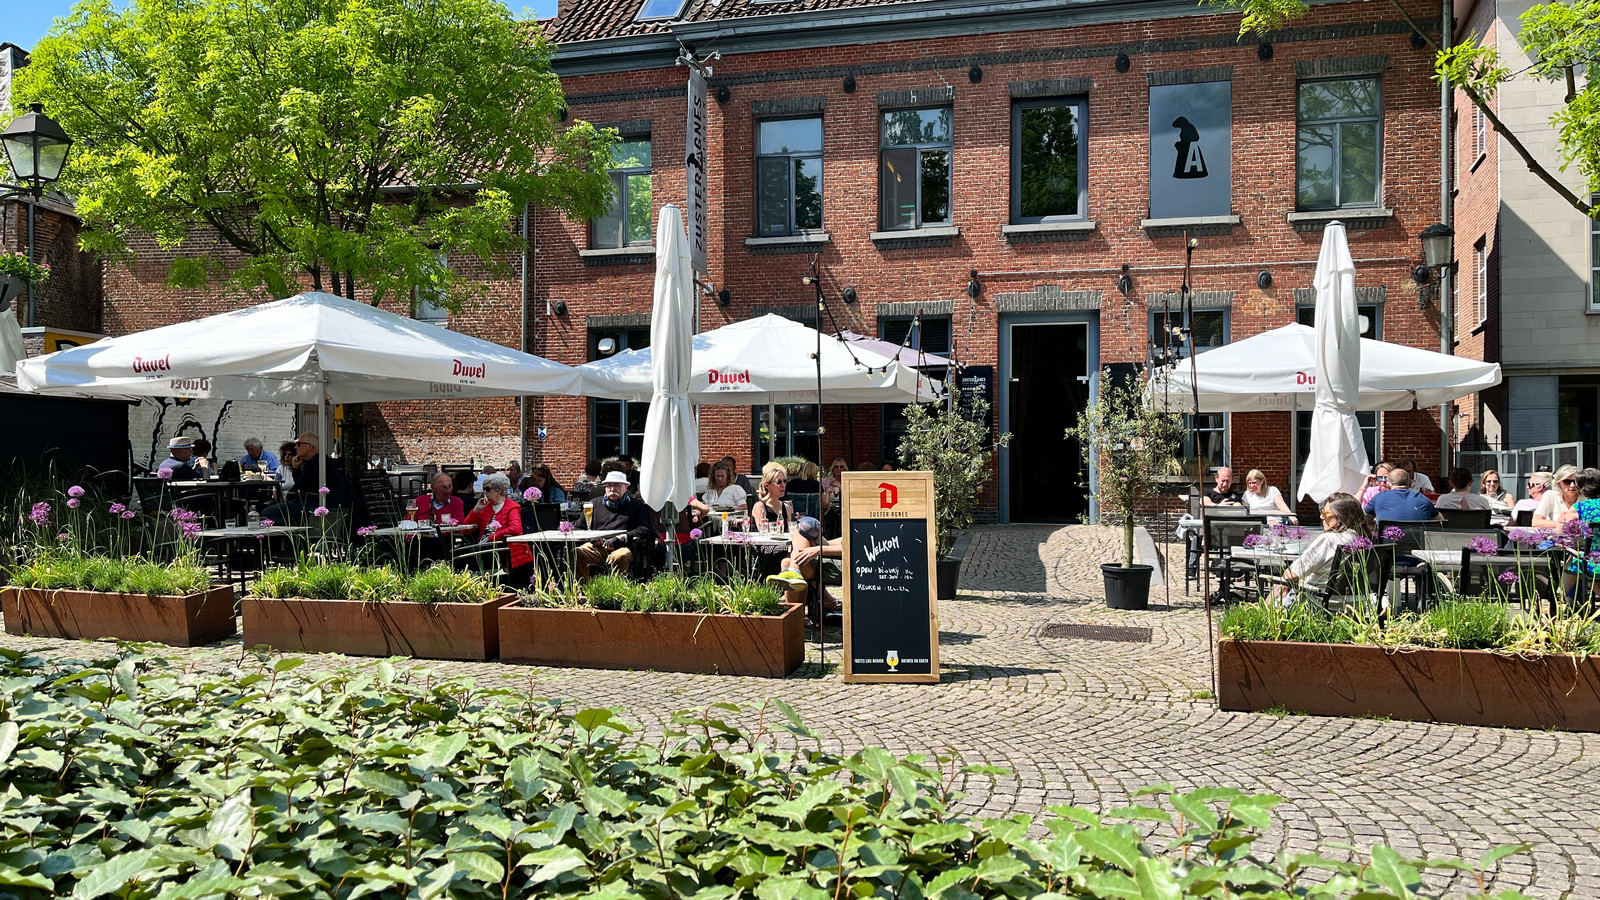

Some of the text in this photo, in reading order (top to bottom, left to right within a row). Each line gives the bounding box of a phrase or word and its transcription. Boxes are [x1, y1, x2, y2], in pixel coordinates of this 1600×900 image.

[693, 95, 703, 252] ZUSTER AGNES
[132, 353, 171, 373] Duvel
[452, 359, 486, 378] Duvel
[708, 369, 751, 384] Duvel
[878, 482, 899, 510] D
